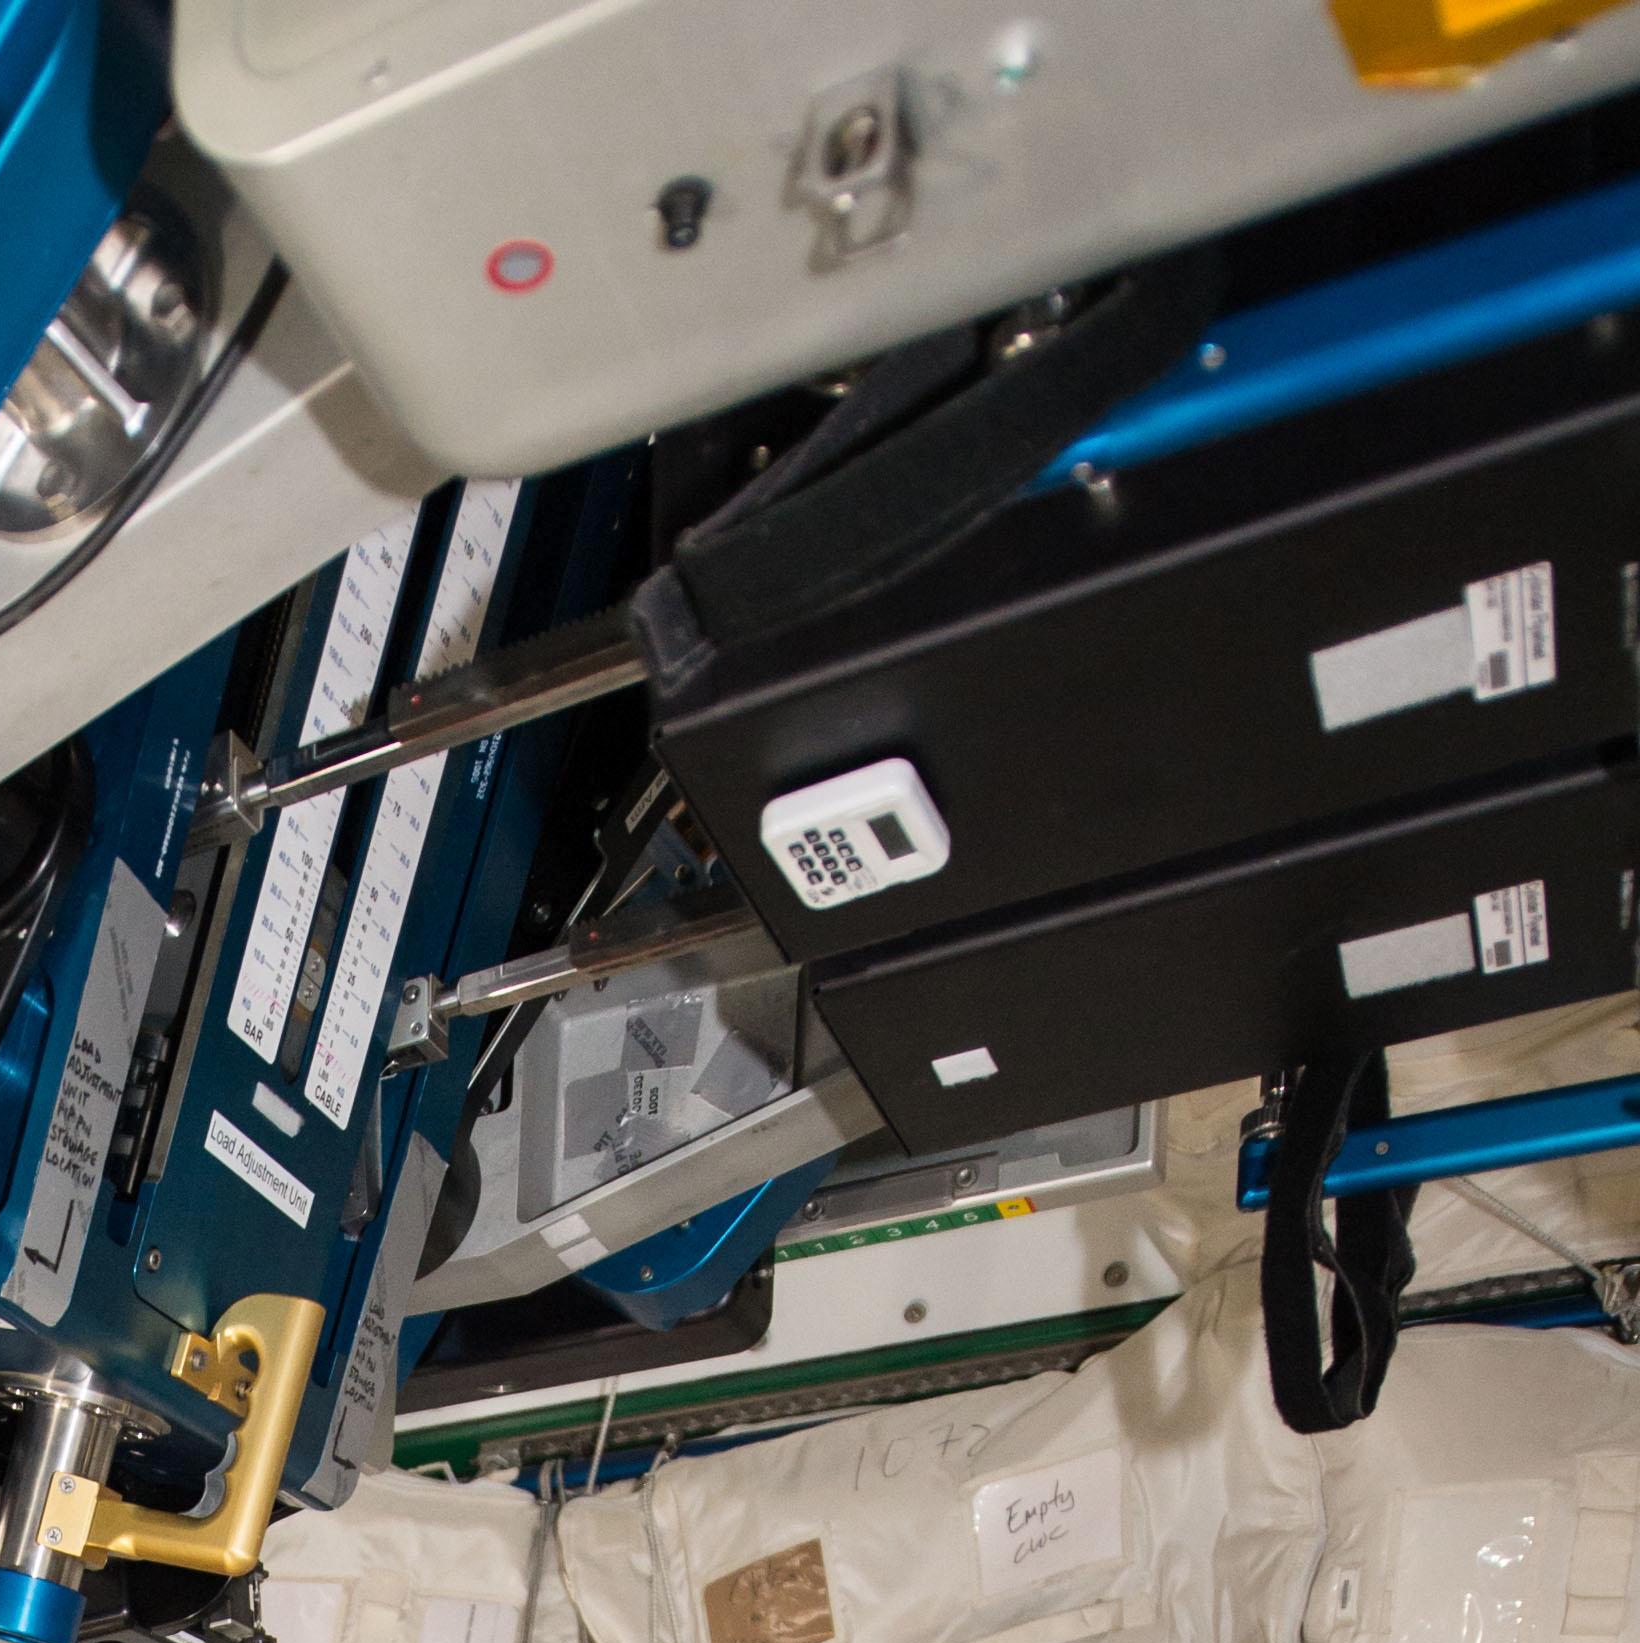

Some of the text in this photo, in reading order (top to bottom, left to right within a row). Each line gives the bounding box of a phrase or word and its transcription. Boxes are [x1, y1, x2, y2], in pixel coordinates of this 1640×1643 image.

[301, 851, 313, 869] 100
[243, 1019, 263, 1045] BAR
[263, 1015, 274, 1032] LBS
[74, 1031, 101, 1063] LOAD
[62, 1079, 90, 1106] UNIT
[67, 1054, 122, 1104] ADJUSTMENT
[314, 1086, 342, 1118] CABLE
[50, 1124, 98, 1167] STOWAGE
[45, 1149, 95, 1187] LOCATION
[210, 1120, 308, 1215] Load Adjustment Unit
[849, 1234, 865, 1244] 2
[887, 1228, 902, 1237] 3
[925, 1220, 940, 1230] 4
[1005, 1480, 1076, 1533] Empty
